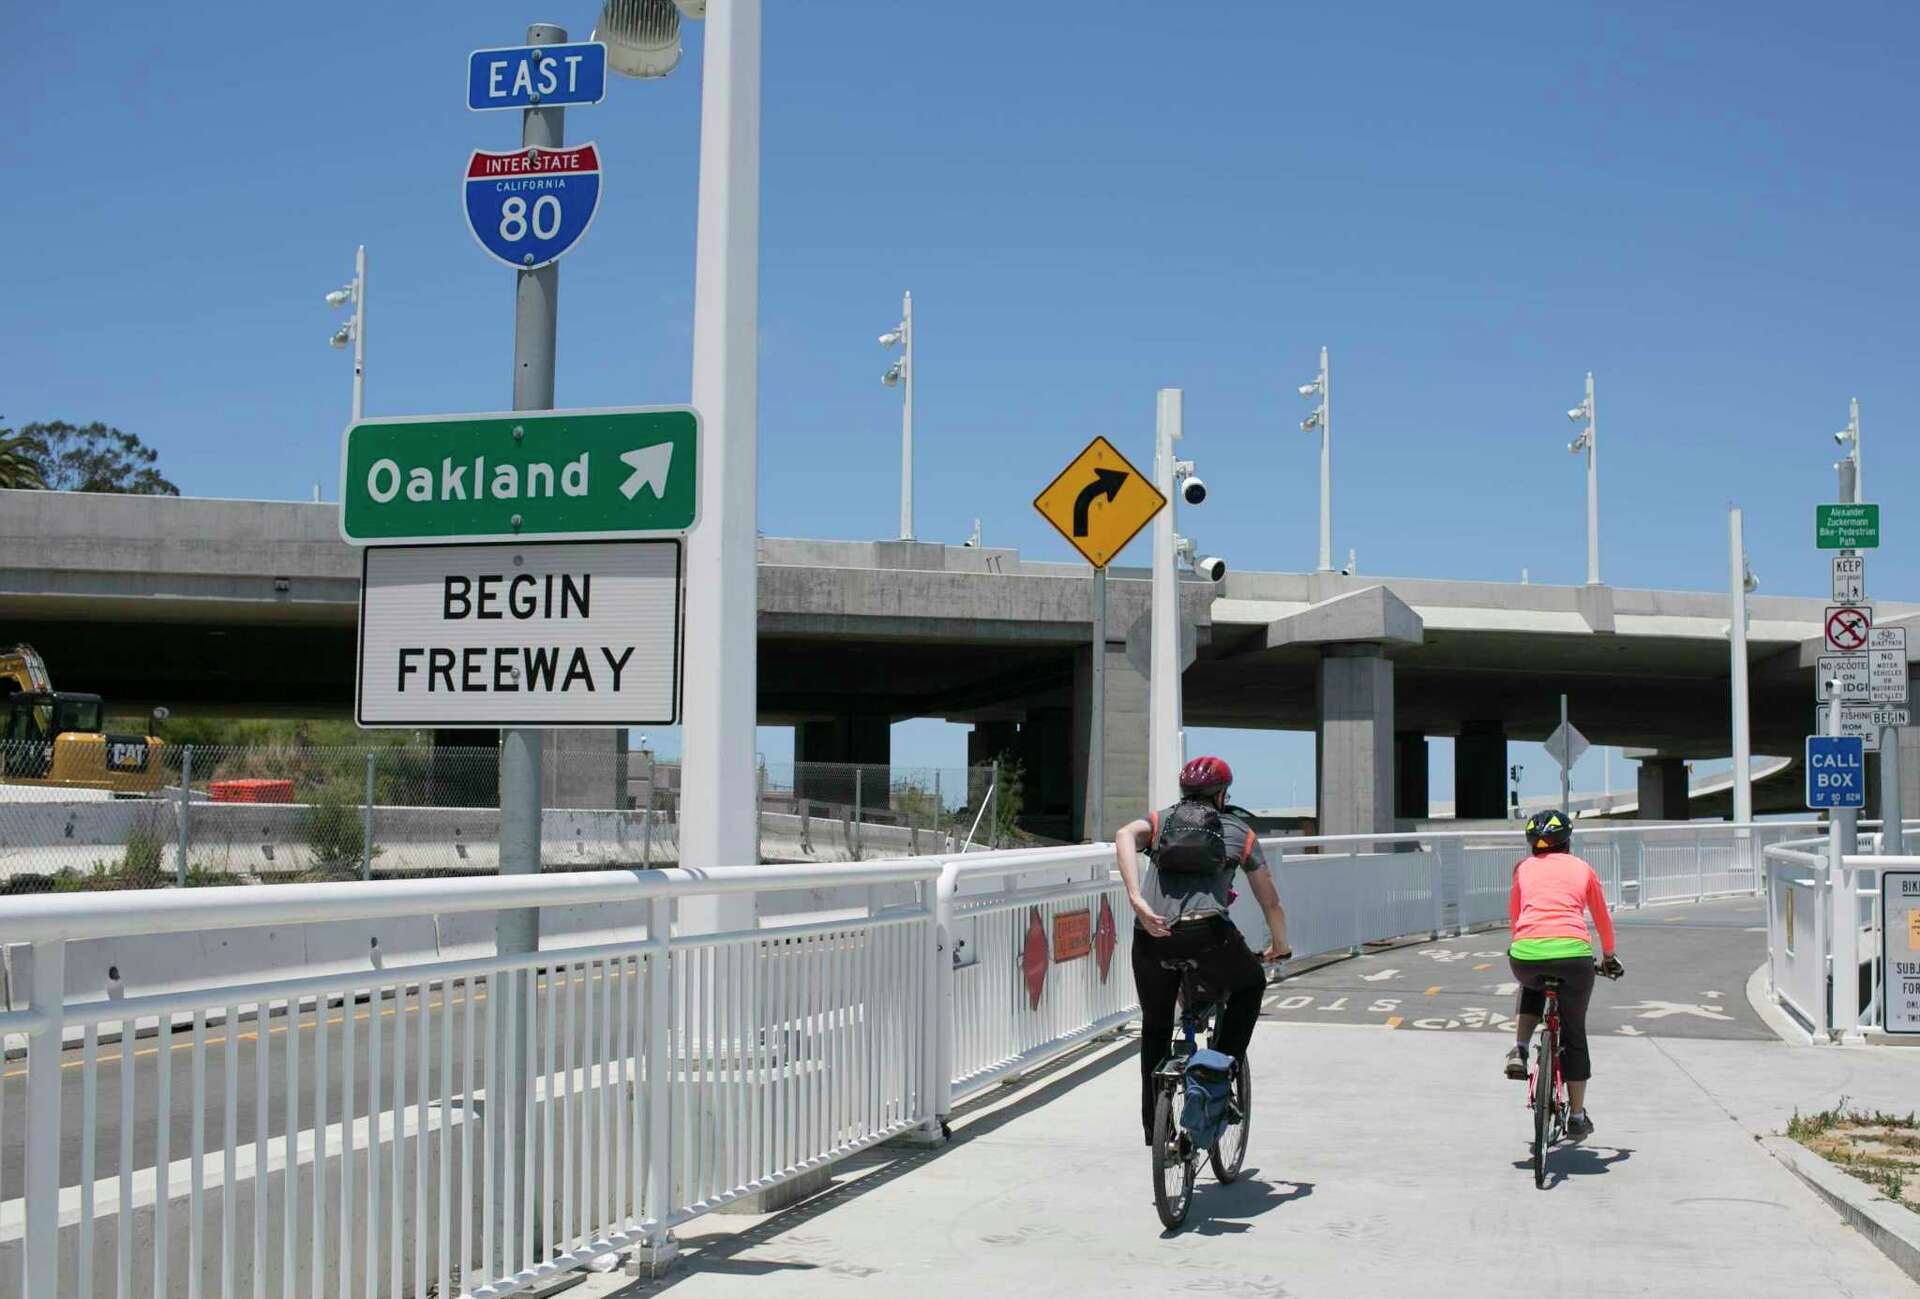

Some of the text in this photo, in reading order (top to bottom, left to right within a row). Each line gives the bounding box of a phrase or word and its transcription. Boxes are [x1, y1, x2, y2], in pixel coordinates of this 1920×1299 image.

[489, 55, 583, 98] EAST
[486, 153, 580, 174] INTERSTATE
[496, 178, 566, 192] CALIFORNIA
[499, 194, 562, 242] 80
[367, 451, 590, 503] Oakland
[1830, 508, 1865, 516] Alexander
[1839, 536, 1856, 546] Path
[1836, 560, 1861, 572] KEEP
[443, 573, 591, 620] BEGIN
[1881, 652, 1894, 661] NO
[397, 646, 636, 692] FREEWAY
[1820, 662, 1832, 670] NO
[1873, 711, 1905, 723] BEGIN
[113, 744, 146, 765] CAT
[1811, 753, 1860, 768] CALL
[1817, 773, 1853, 787] BOX
[1902, 879, 1920, 892] BIK
